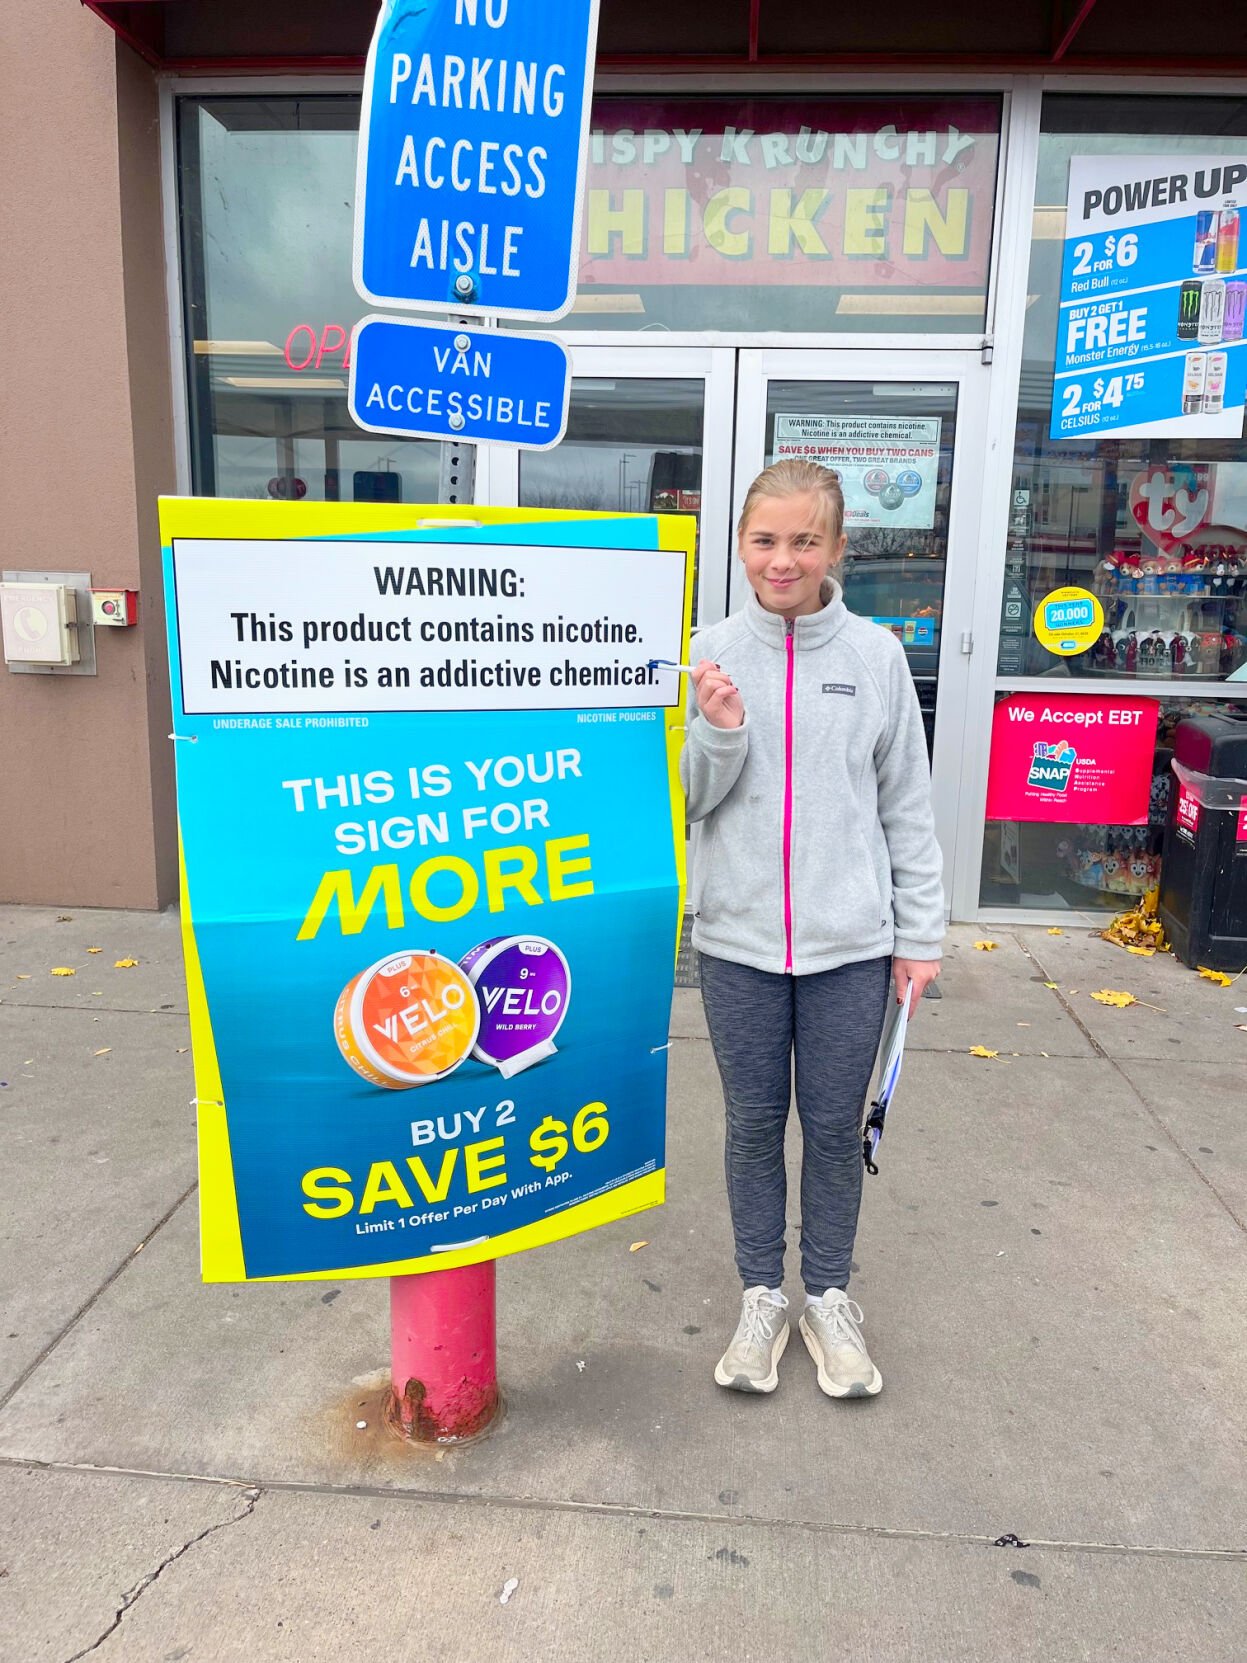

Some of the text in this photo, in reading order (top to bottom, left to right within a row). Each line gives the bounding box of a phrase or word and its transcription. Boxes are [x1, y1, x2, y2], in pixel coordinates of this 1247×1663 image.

[390, 53, 565, 117] PARKING
[591, 124, 976, 169] ISPY KRUNCHY
[395, 135, 547, 198] ACCESS
[1083, 164, 1247, 220] POWER UP
[587, 188, 970, 257] HICKEN
[410, 218, 523, 277] AISLE
[1072, 233, 1139, 276] 2 FOR $6
[1071, 280, 1089, 293] Red
[1091, 276, 1109, 289] Bull
[1069, 305, 1090, 320] BUY
[1091, 304, 1098, 316] 2
[1098, 302, 1118, 315] GET
[284, 324, 353, 370] OP
[1066, 307, 1148, 353] FREE
[433, 346, 491, 378] VAN
[1065, 348, 1106, 366] Monster
[1107, 343, 1140, 358] Energy
[366, 383, 550, 428] ACCESSIBLE
[1061, 384, 1082, 417] 2
[1082, 401, 1101, 413] FOR
[789, 419, 926, 430] WARNING: This product contains nicotine.
[802, 429, 830, 437] Nicotine
[848, 430, 878, 438] addictive
[1061, 413, 1100, 430] CELSIUS
[778, 446, 802, 454] SAVE
[818, 446, 844, 455] WHEN
[846, 447, 864, 456] YOU
[866, 448, 886, 456] BUY
[887, 448, 907, 456] TWO
[908, 449, 934, 457] CANS
[1139, 472, 1209, 538] ty
[374, 566, 525, 598] WARNING:
[230, 612, 643, 649] This product contains nicotine.
[210, 659, 660, 689] Nicotine is an addictive chemical.
[213, 717, 369, 730] UNDERAGE SALE PROHIBITED
[577, 711, 656, 724] NICOTINE POUCHES
[1008, 706, 1143, 728] We Accept EBT
[1029, 766, 1070, 780] SNAP
[1076, 758, 1096, 766] USDA
[282, 748, 582, 812] THIS IS YOUR
[334, 798, 550, 855] SIGN FOR
[296, 833, 594, 941] MORE
[525, 945, 542, 953] PLUS
[387, 960, 407, 974] PLUS
[372, 983, 466, 1044] VELO
[482, 986, 561, 1016] VELO
[410, 1100, 516, 1147] BUY 2
[301, 1135, 508, 1220] SAVE
[529, 1101, 611, 1173] $6
[356, 1170, 573, 1236] Limit 1 Offer Per Day With App.
